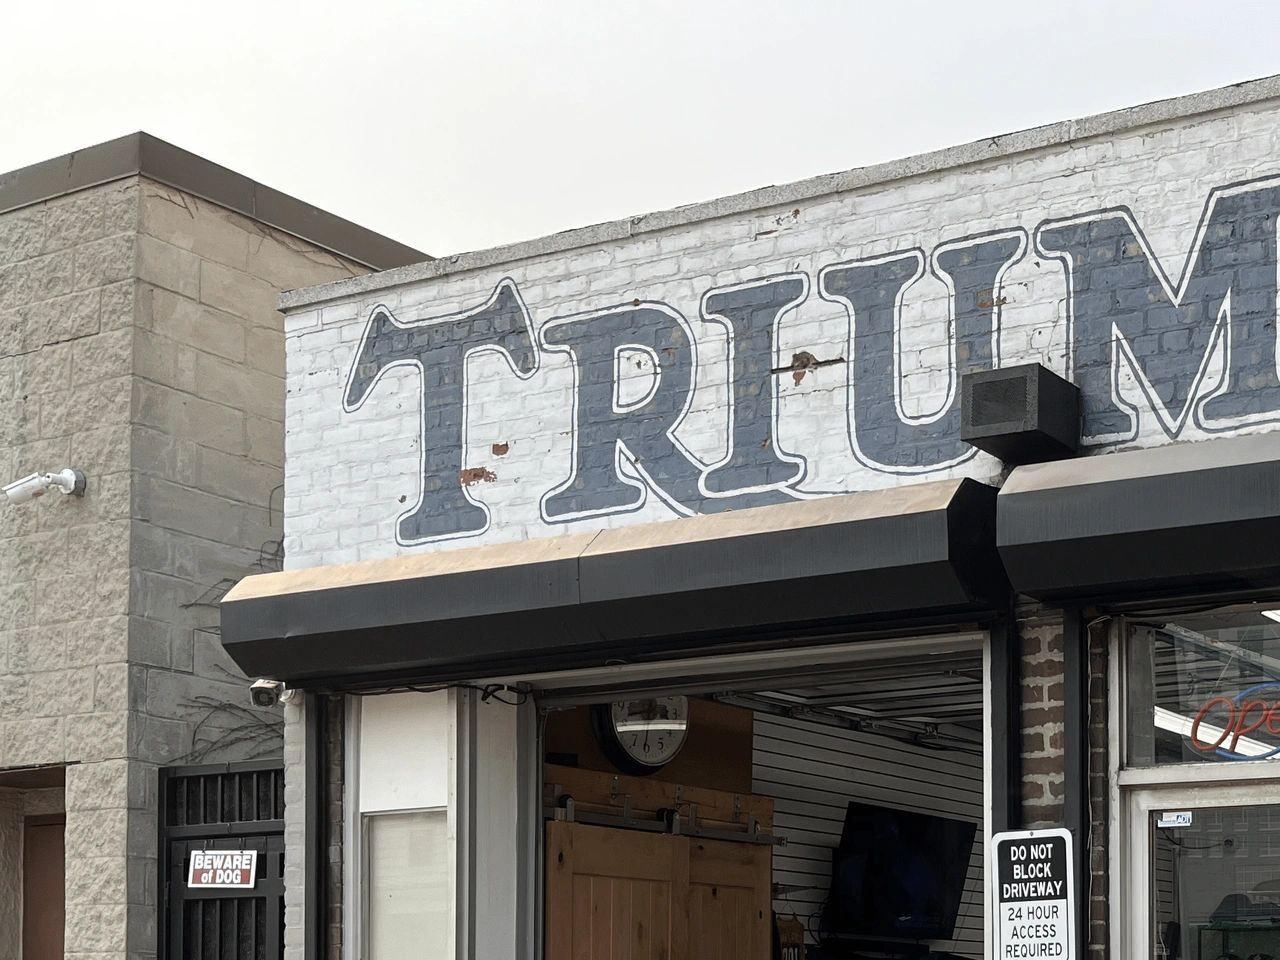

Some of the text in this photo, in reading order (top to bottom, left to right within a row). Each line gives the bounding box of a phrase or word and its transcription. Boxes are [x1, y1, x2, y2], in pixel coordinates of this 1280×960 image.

[1010, 843, 1053, 861] DO NOT
[194, 855, 251, 869] BEWARE
[201, 869, 242, 884] of DOG
[1013, 862, 1052, 880] BLOCK
[1003, 880, 1063, 899] DRIVEWAY
[1007, 905, 1059, 921] 24 HOUR
[1011, 924, 1057, 939] ACCESS
[1006, 942, 1063, 958] REQUIRED
